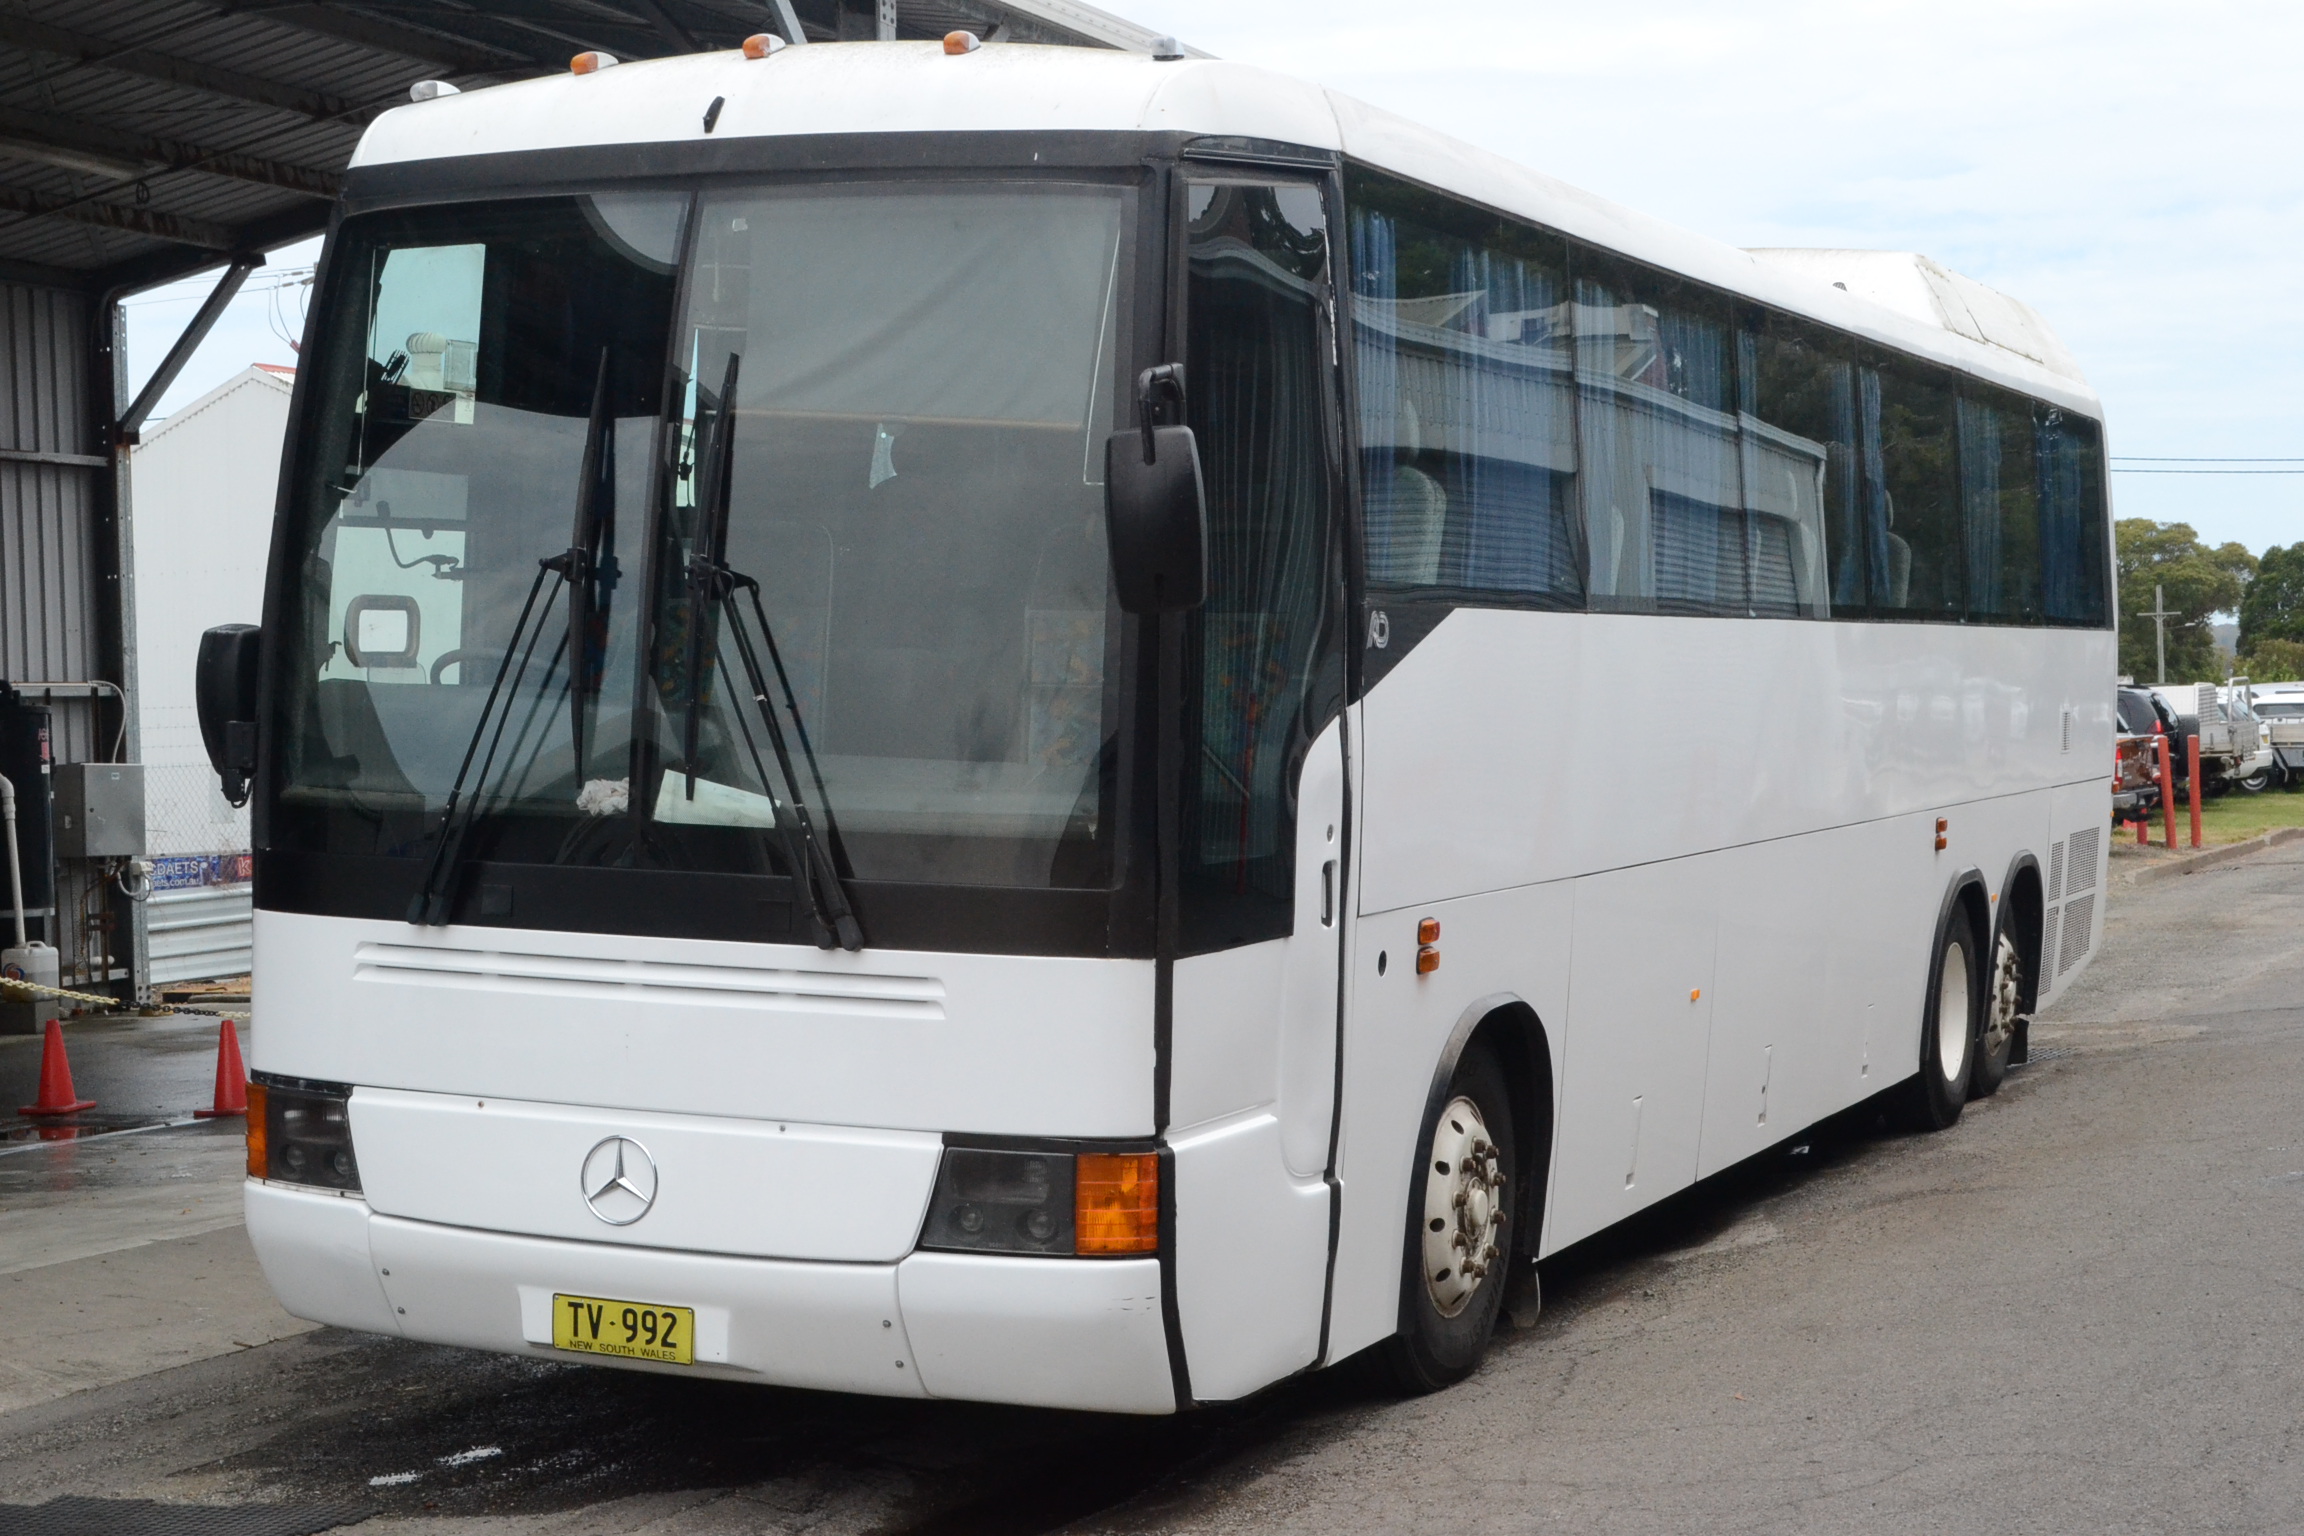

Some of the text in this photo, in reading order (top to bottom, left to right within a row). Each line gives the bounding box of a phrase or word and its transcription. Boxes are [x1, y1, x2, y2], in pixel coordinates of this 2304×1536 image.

[569, 1339, 676, 1360] NEW SOUTH WALES
